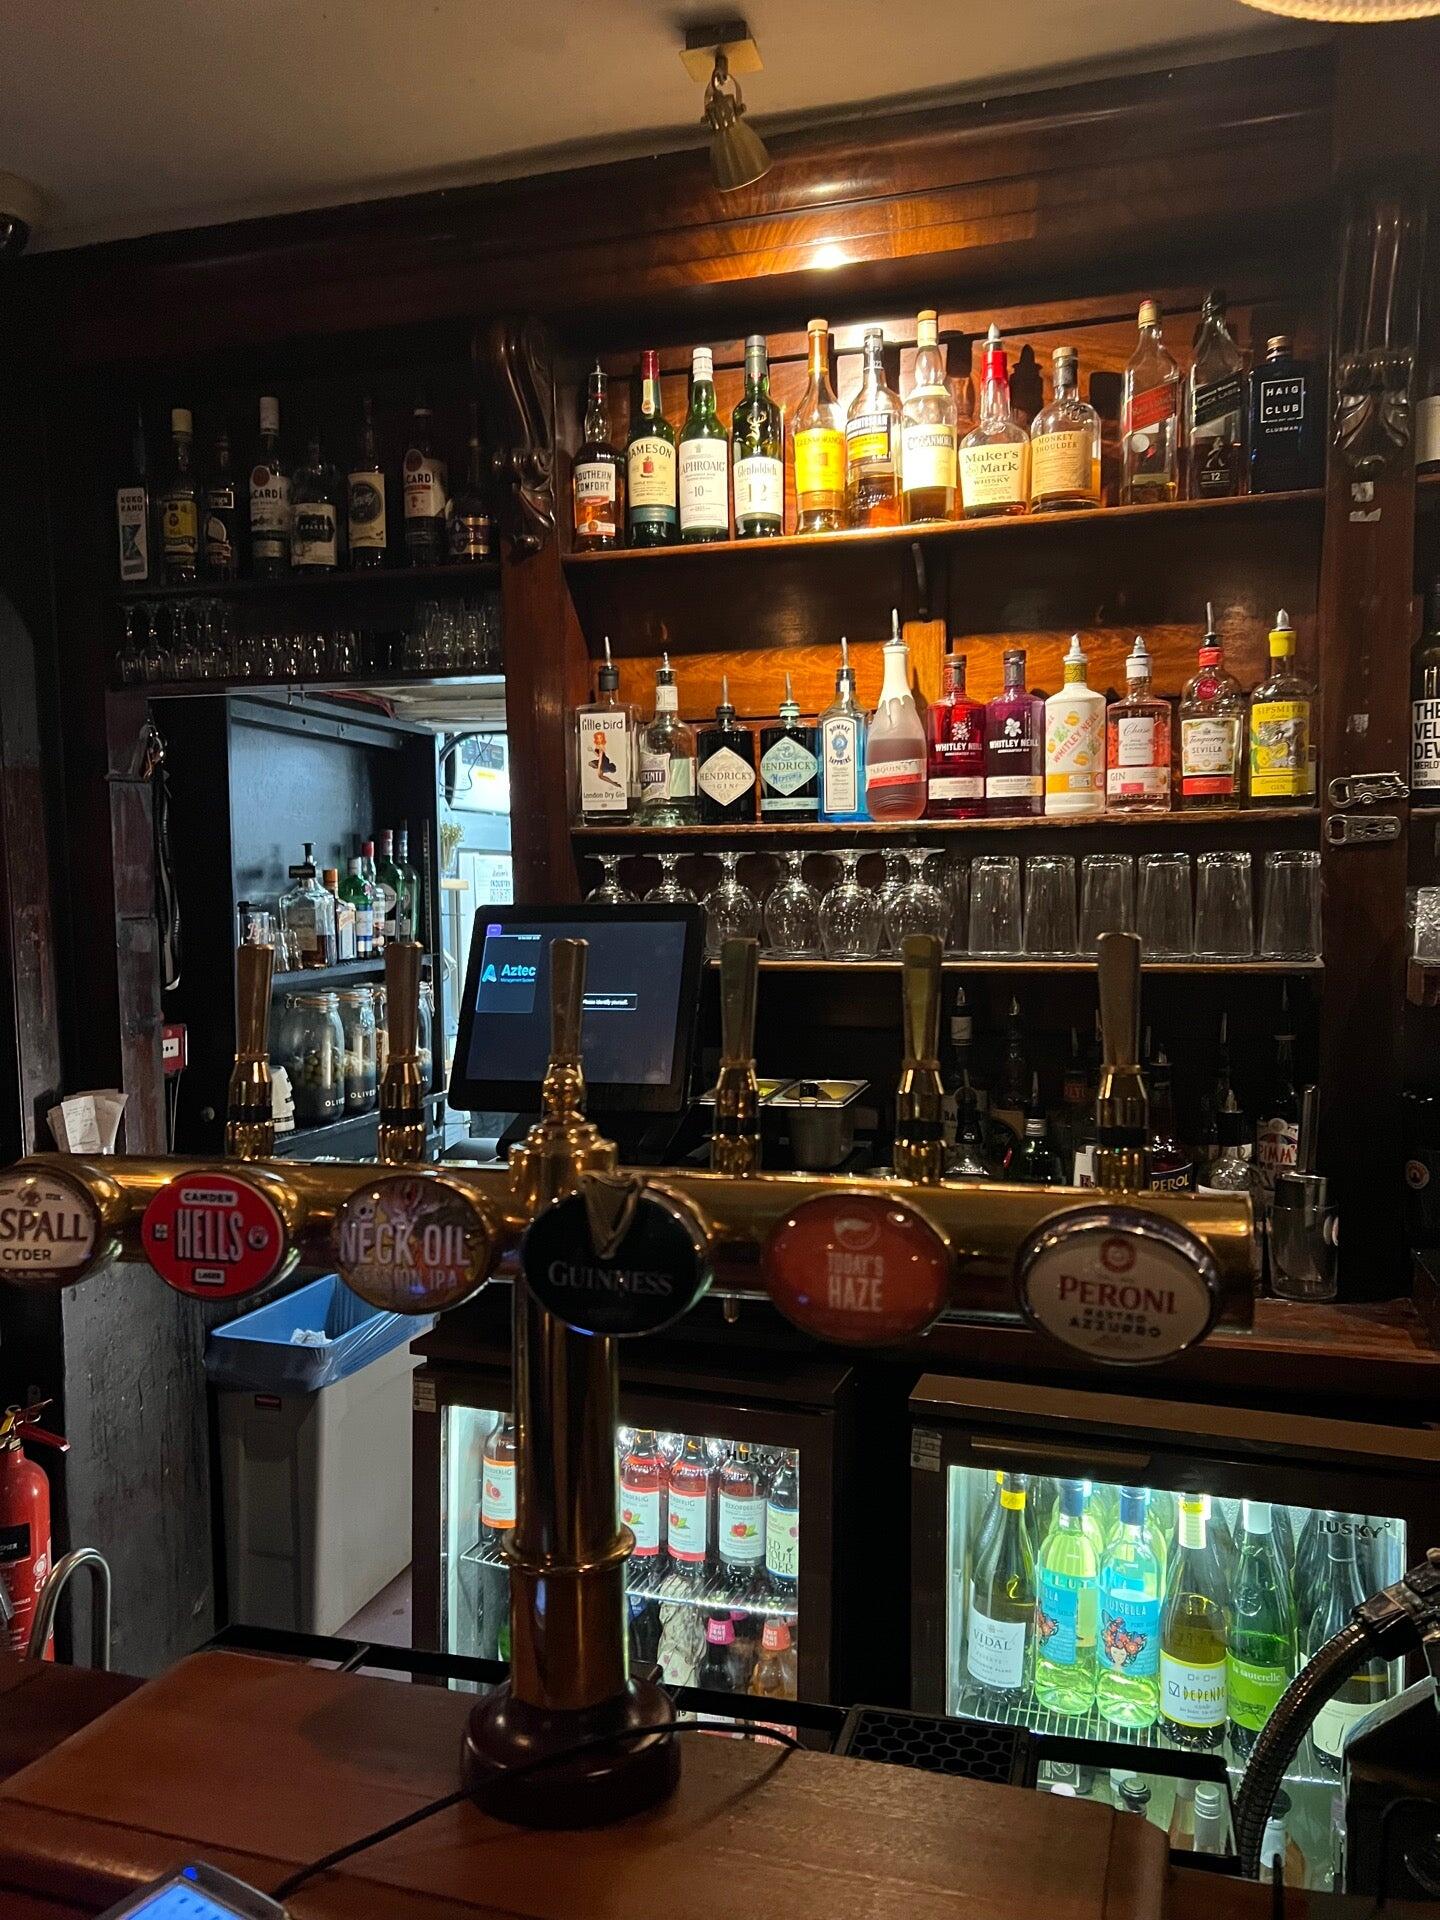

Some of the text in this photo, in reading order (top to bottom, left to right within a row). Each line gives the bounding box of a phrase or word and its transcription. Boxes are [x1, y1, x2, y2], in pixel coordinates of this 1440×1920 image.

[1265, 386, 1299, 397] HAIG
[1265, 404, 1300, 415] CLUB
[1038, 433, 1074, 445] MONKEY
[628, 443, 673, 460] JAMESON
[1036, 441, 1078, 454] SHOULDER
[965, 450, 1019, 464] Maker's
[680, 460, 726, 475] APHROAIG
[980, 461, 1019, 474] Mark
[576, 470, 612, 481] SOUTHERN
[973, 476, 1010, 486] WHISKY
[1210, 472, 1221, 481] 12
[576, 481, 610, 493] COMFORT
[694, 485, 704, 497] 10
[1414, 701, 1440, 720] THE
[603, 719, 624, 730] bird
[935, 742, 967, 752] WHITLEY
[989, 738, 1040, 750] WHITLEY NEILL
[1054, 731, 1081, 764] WHITLEY
[1191, 745, 1222, 754] SEVILLA
[701, 771, 752, 781] HENDRICK'S
[1110, 772, 1126, 781] GIN
[583, 790, 626, 800] London Dry Gin
[501, 964, 536, 976] Aztec
[184, 1192, 233, 1203] CAMDEN
[176, 1208, 244, 1262] HELLS
[340, 1219, 471, 1267] NECK OIL
[3, 1248, 51, 1261] CYDER
[429, 1267, 459, 1291] IPA
[548, 1260, 674, 1297] GUINNESS
[829, 1276, 882, 1312] HAZE
[1059, 1274, 1177, 1315] PERONI
[768, 1559, 794, 1574] IDER
[973, 1628, 1013, 1651] VIDAL
